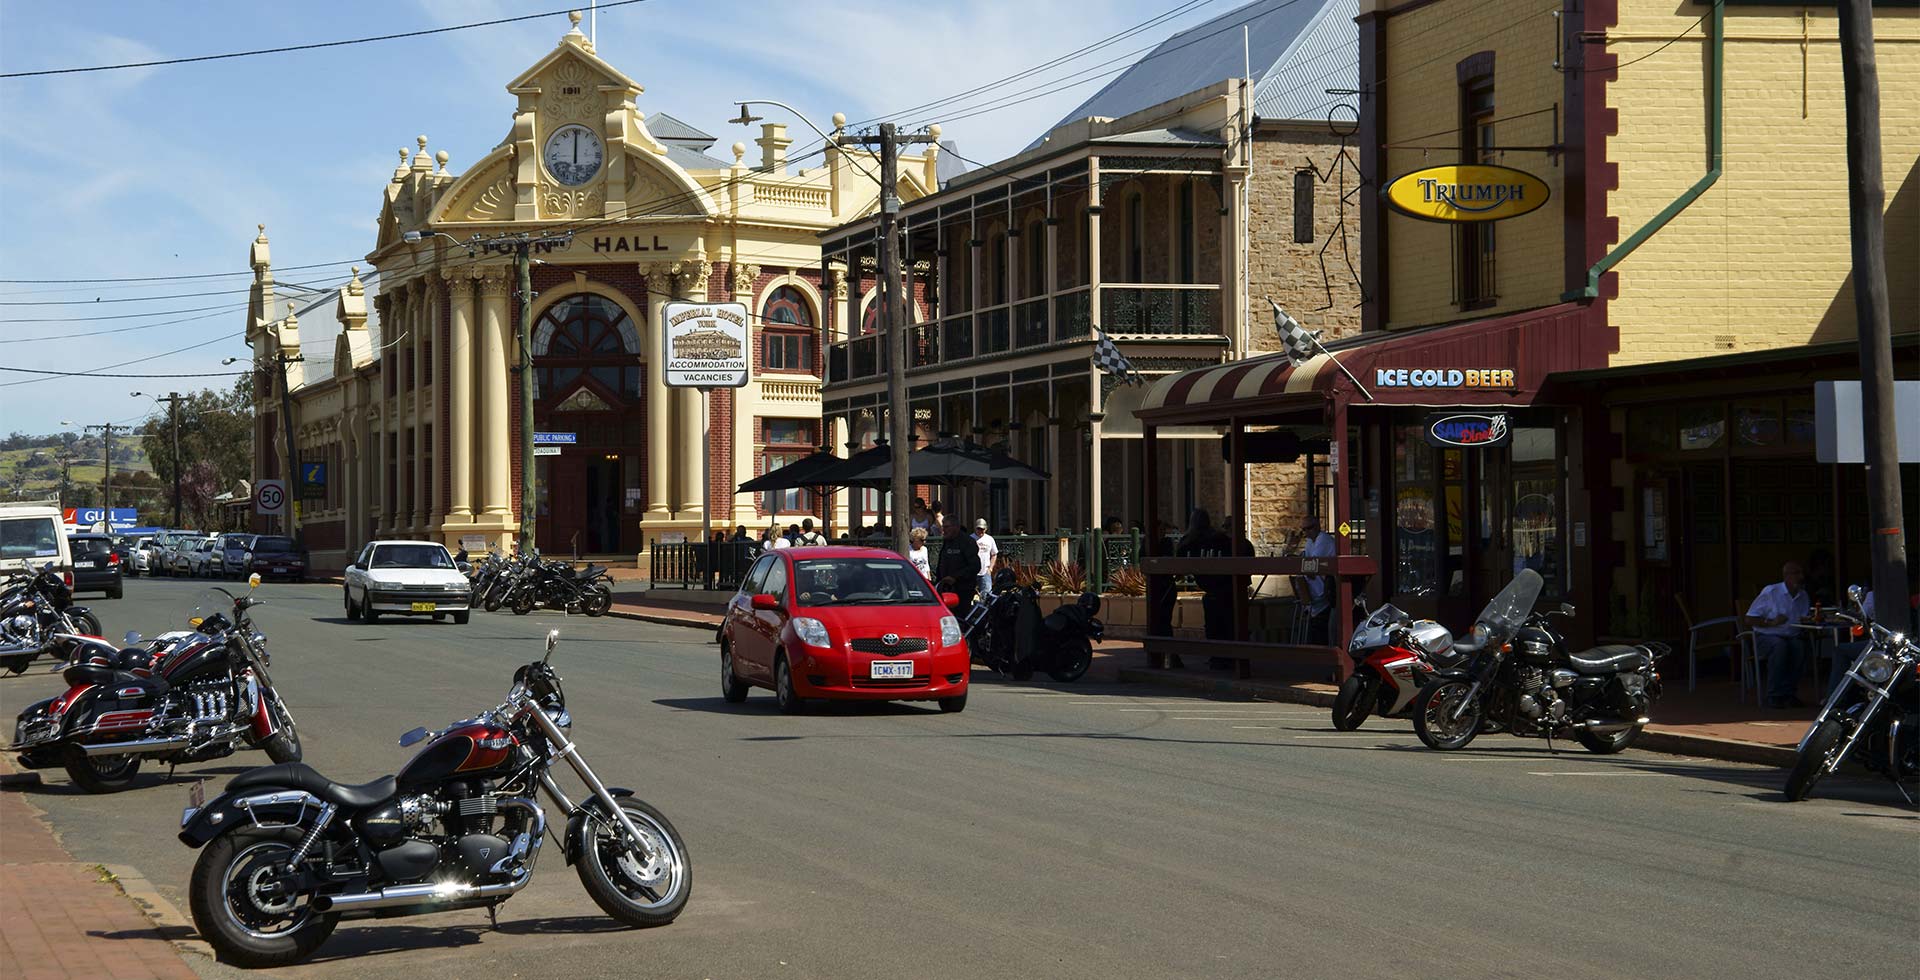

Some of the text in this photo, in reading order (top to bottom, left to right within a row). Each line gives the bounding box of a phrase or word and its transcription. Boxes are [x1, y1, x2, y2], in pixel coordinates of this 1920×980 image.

[563, 87, 580, 95] 1911
[482, 235, 669, 255] ON HALL
[669, 308, 744, 327] IMPERIAL HOTEL
[669, 361, 745, 369] ACCOMMODATION
[683, 373, 733, 381] VACANCIES
[1376, 368, 1515, 388] ICE COLD BEER
[534, 434, 573, 442] PUBLIC PARKING
[262, 490, 281, 504] 50
[85, 510, 118, 521] GUL
